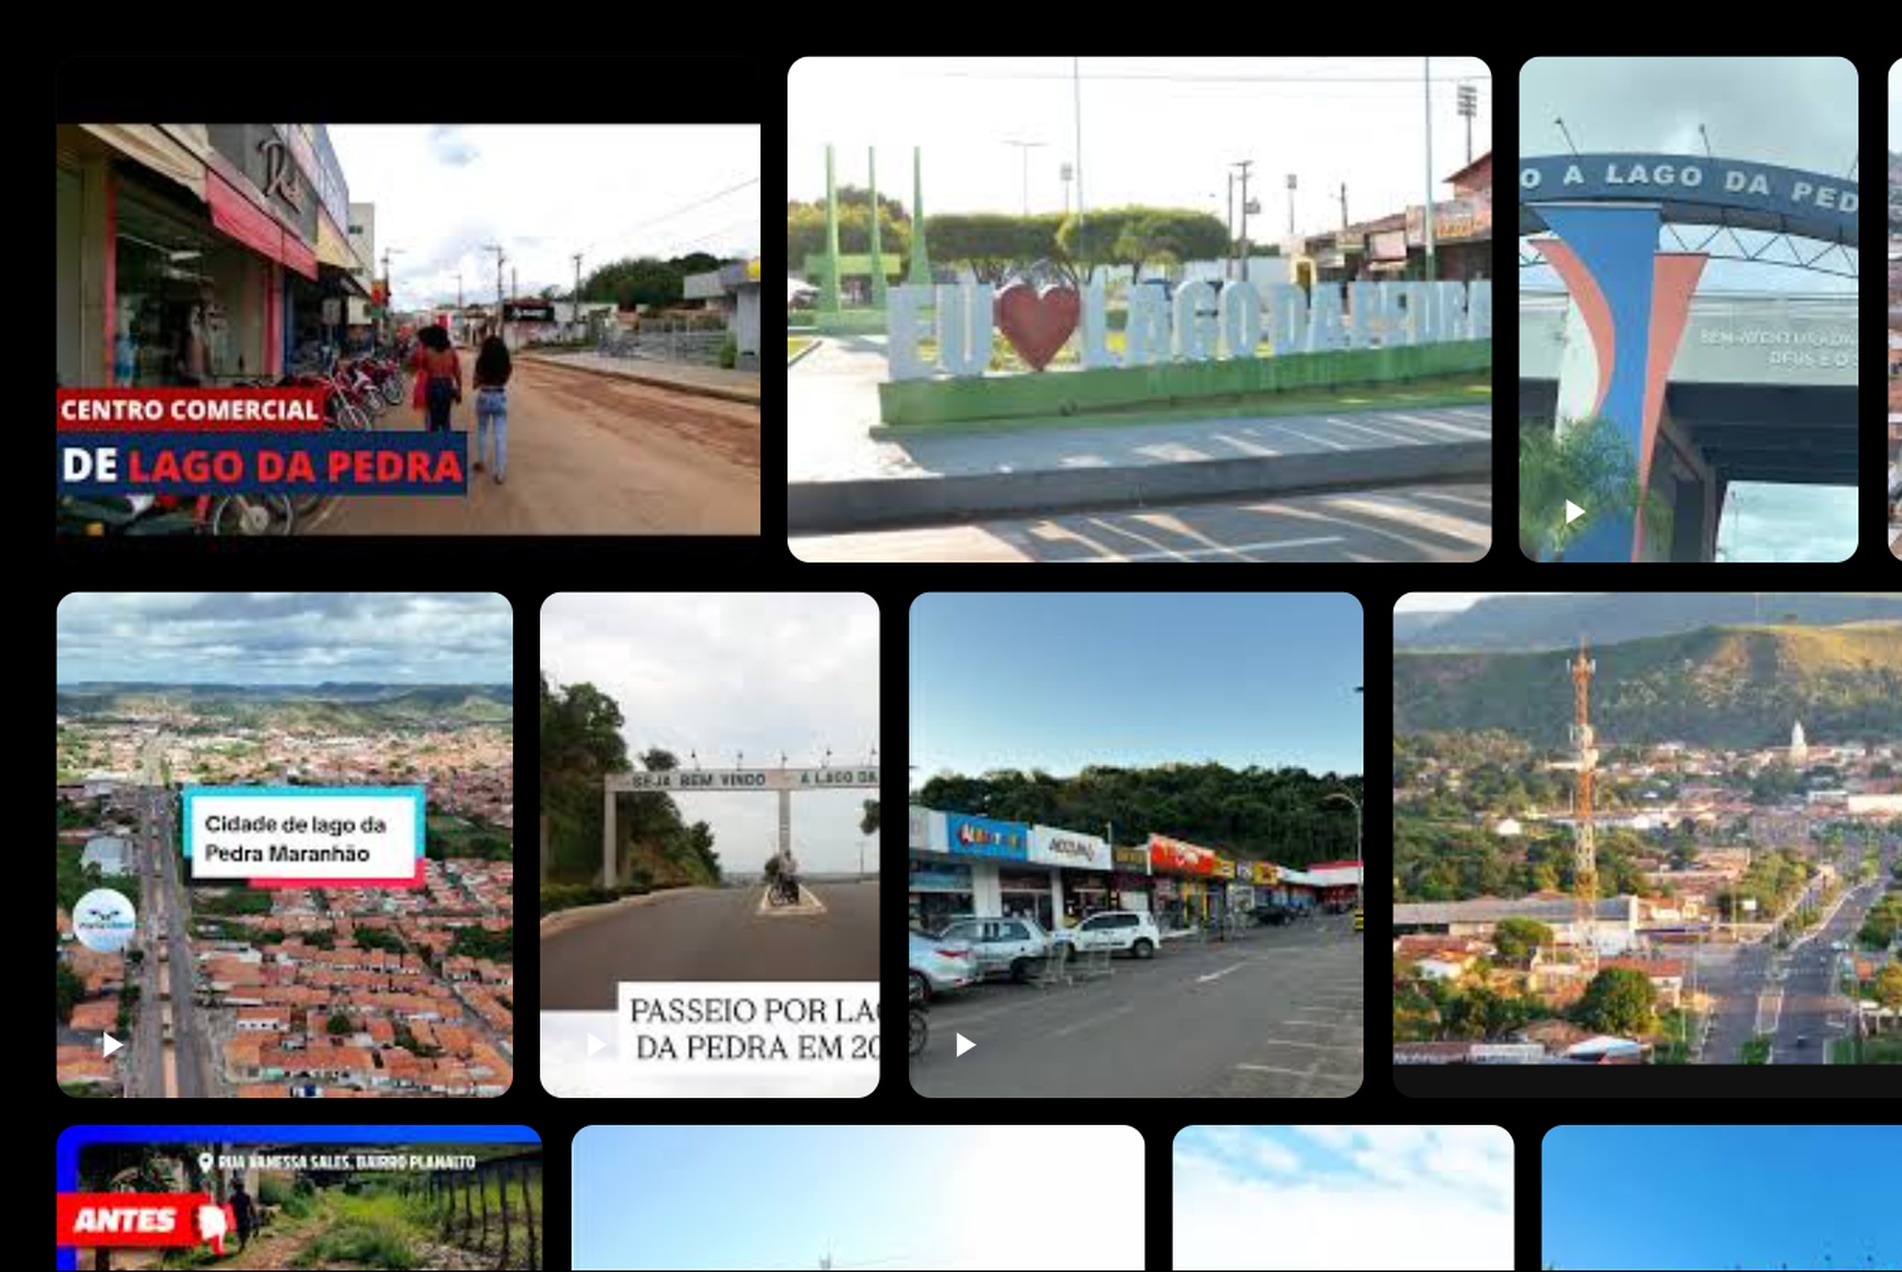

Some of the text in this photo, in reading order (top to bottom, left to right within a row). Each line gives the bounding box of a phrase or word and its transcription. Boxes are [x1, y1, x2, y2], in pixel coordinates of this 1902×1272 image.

[1563, 166, 1584, 185] A
[1605, 164, 1702, 186] LAGO
[1724, 170, 1770, 195] DA
[888, 280, 995, 380] EU
[1080, 280, 1262, 370] LAGO
[680, 773, 713, 787] BEM
[721, 773, 766, 787] VINDO
[801, 772, 809, 784] A
